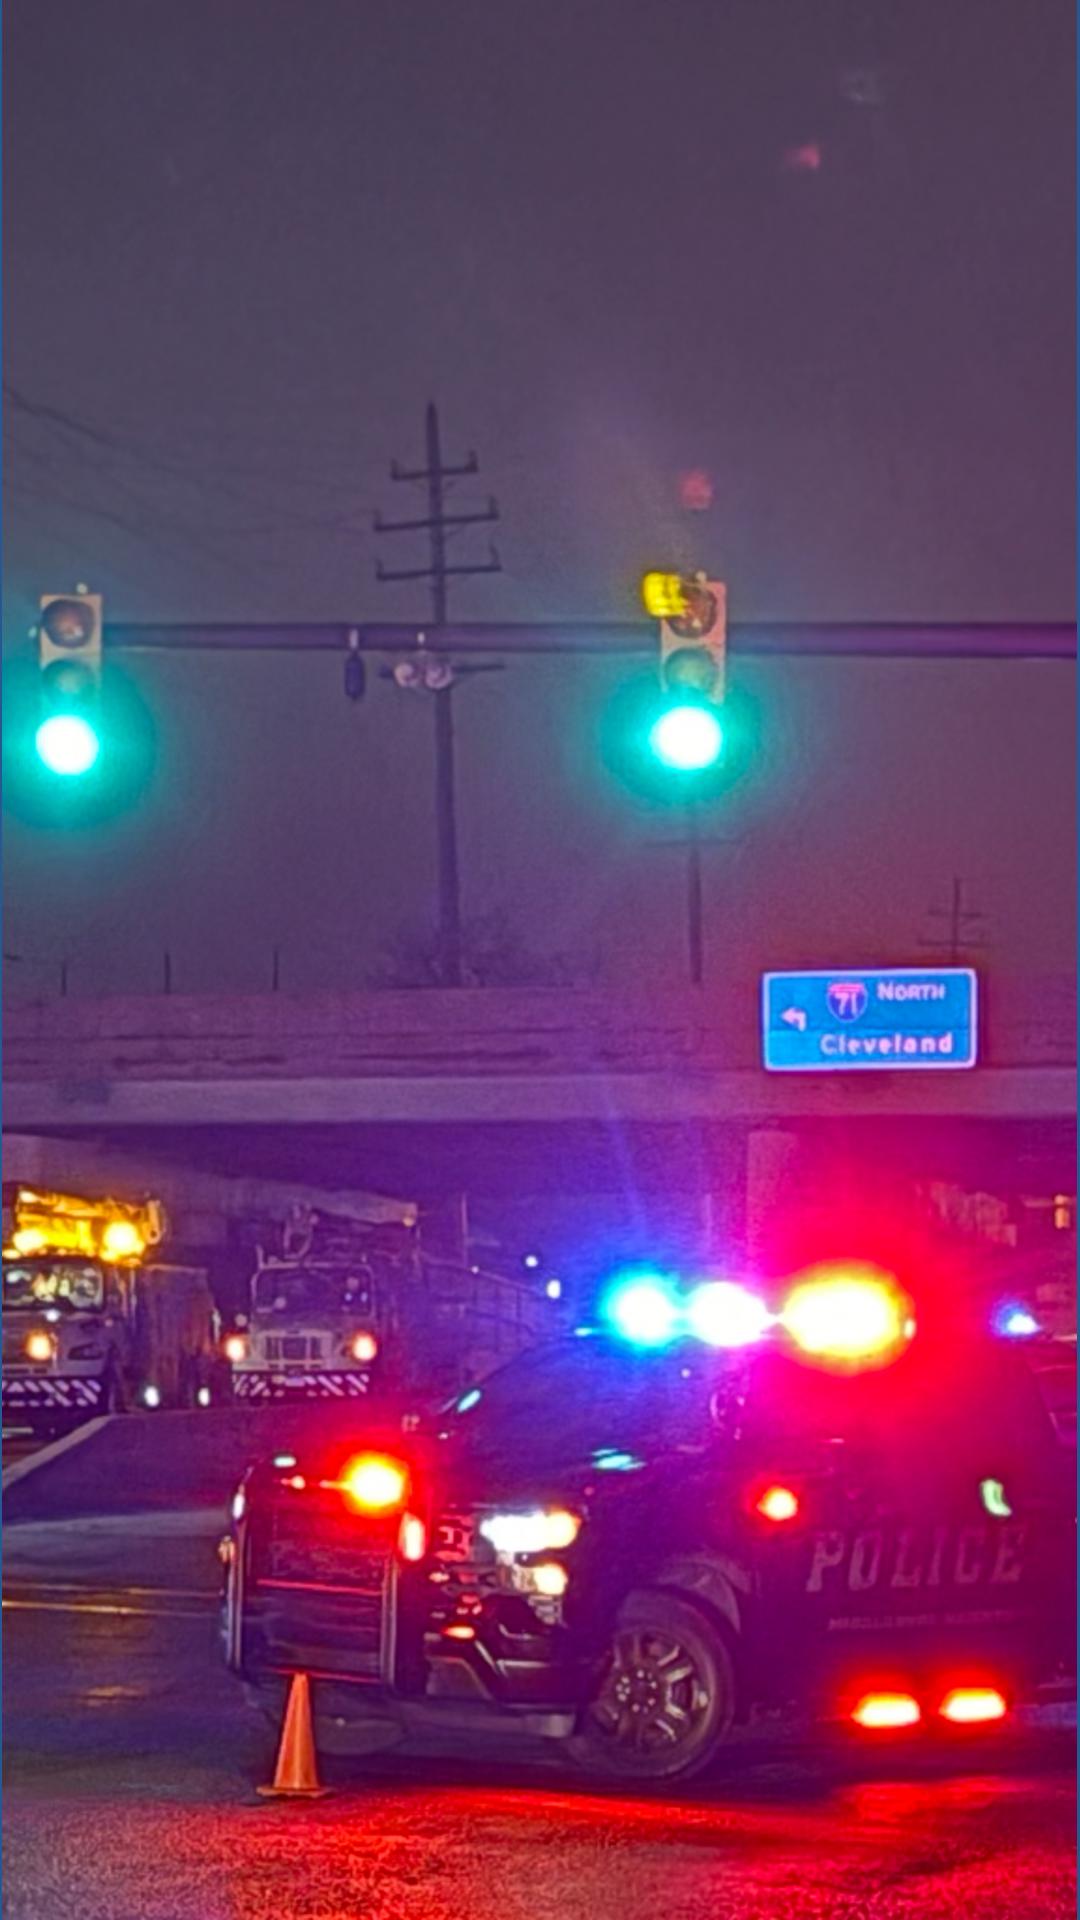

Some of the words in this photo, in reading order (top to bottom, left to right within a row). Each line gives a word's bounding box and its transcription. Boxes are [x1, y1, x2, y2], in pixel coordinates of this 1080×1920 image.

[835, 991, 859, 1016] 71
[877, 982, 946, 1001] NORTH
[820, 1032, 954, 1055] Cleveland
[805, 1527, 1028, 1592] POLICE
